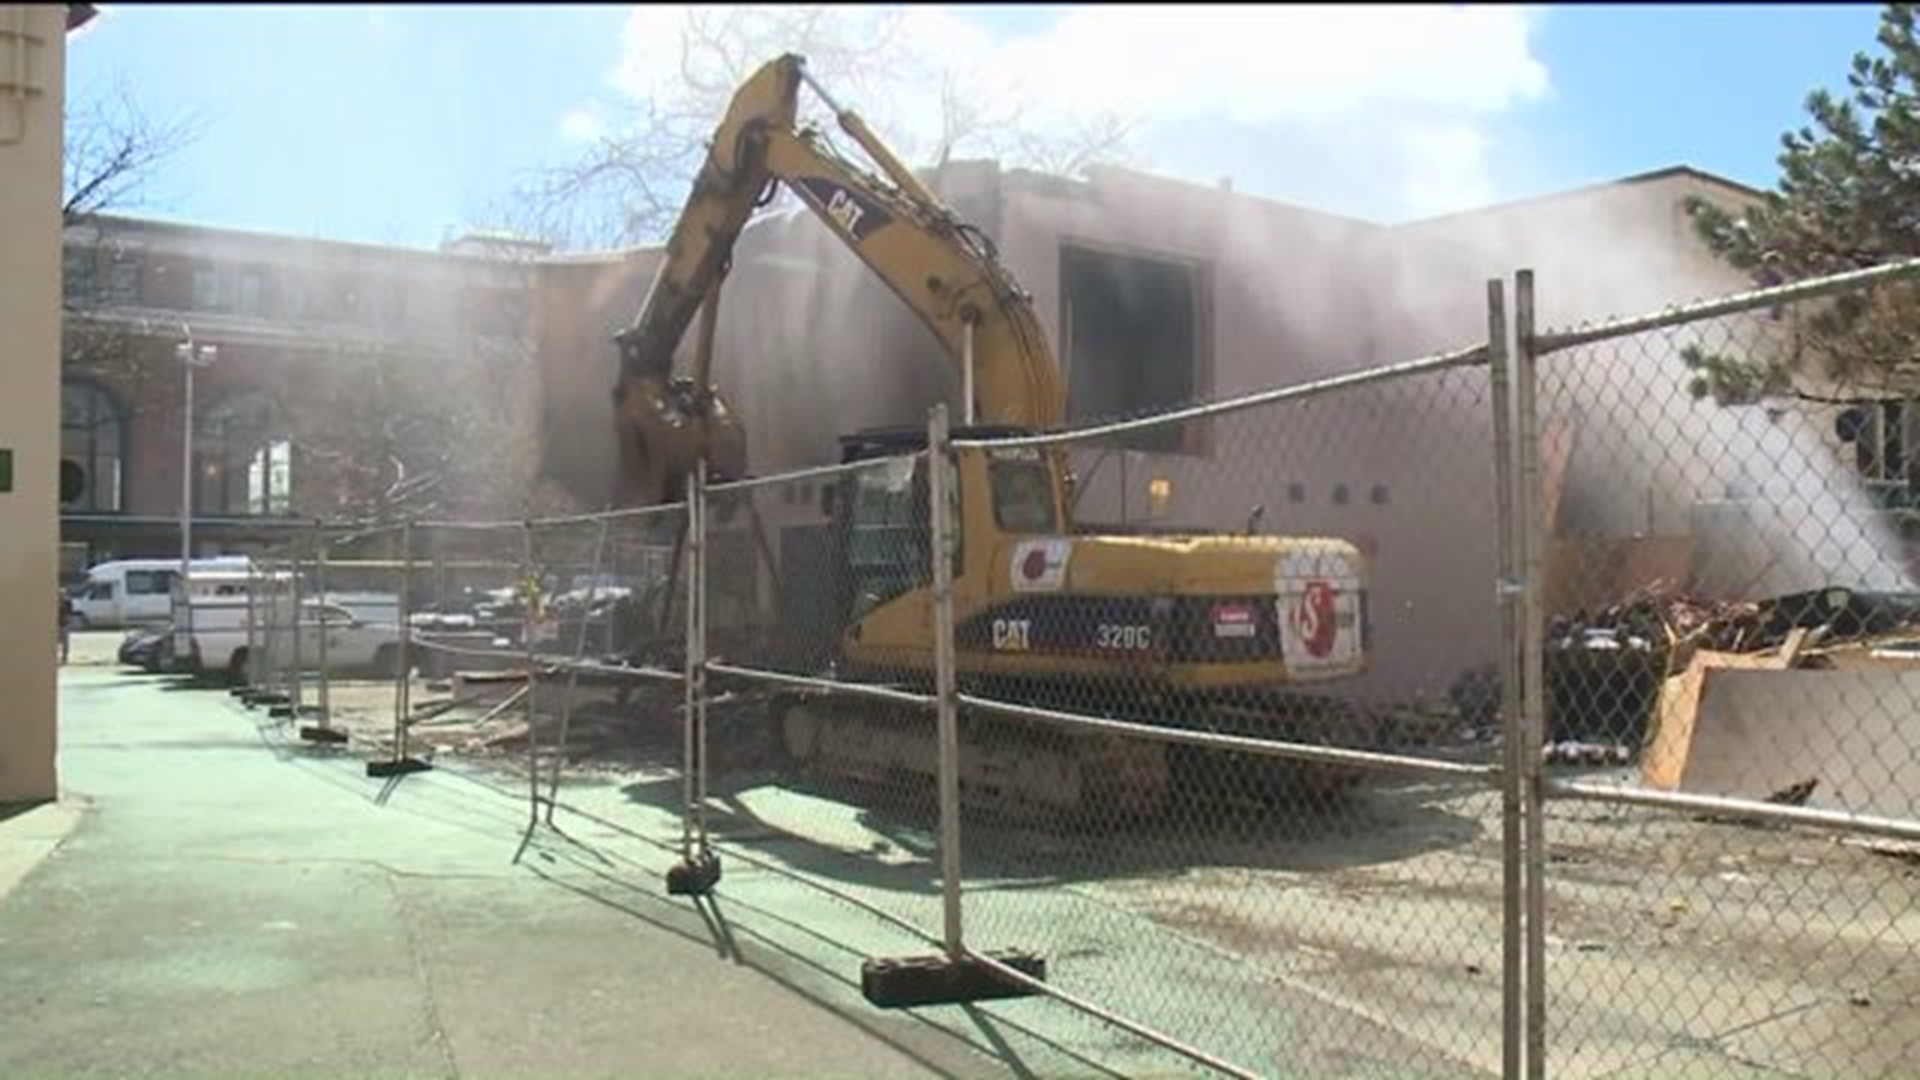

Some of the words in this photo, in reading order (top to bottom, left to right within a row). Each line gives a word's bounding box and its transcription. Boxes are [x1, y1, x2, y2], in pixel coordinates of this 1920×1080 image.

[827, 190, 864, 233] CAT
[993, 620, 1031, 652] CAT
[1097, 624, 1151, 650] 320C
